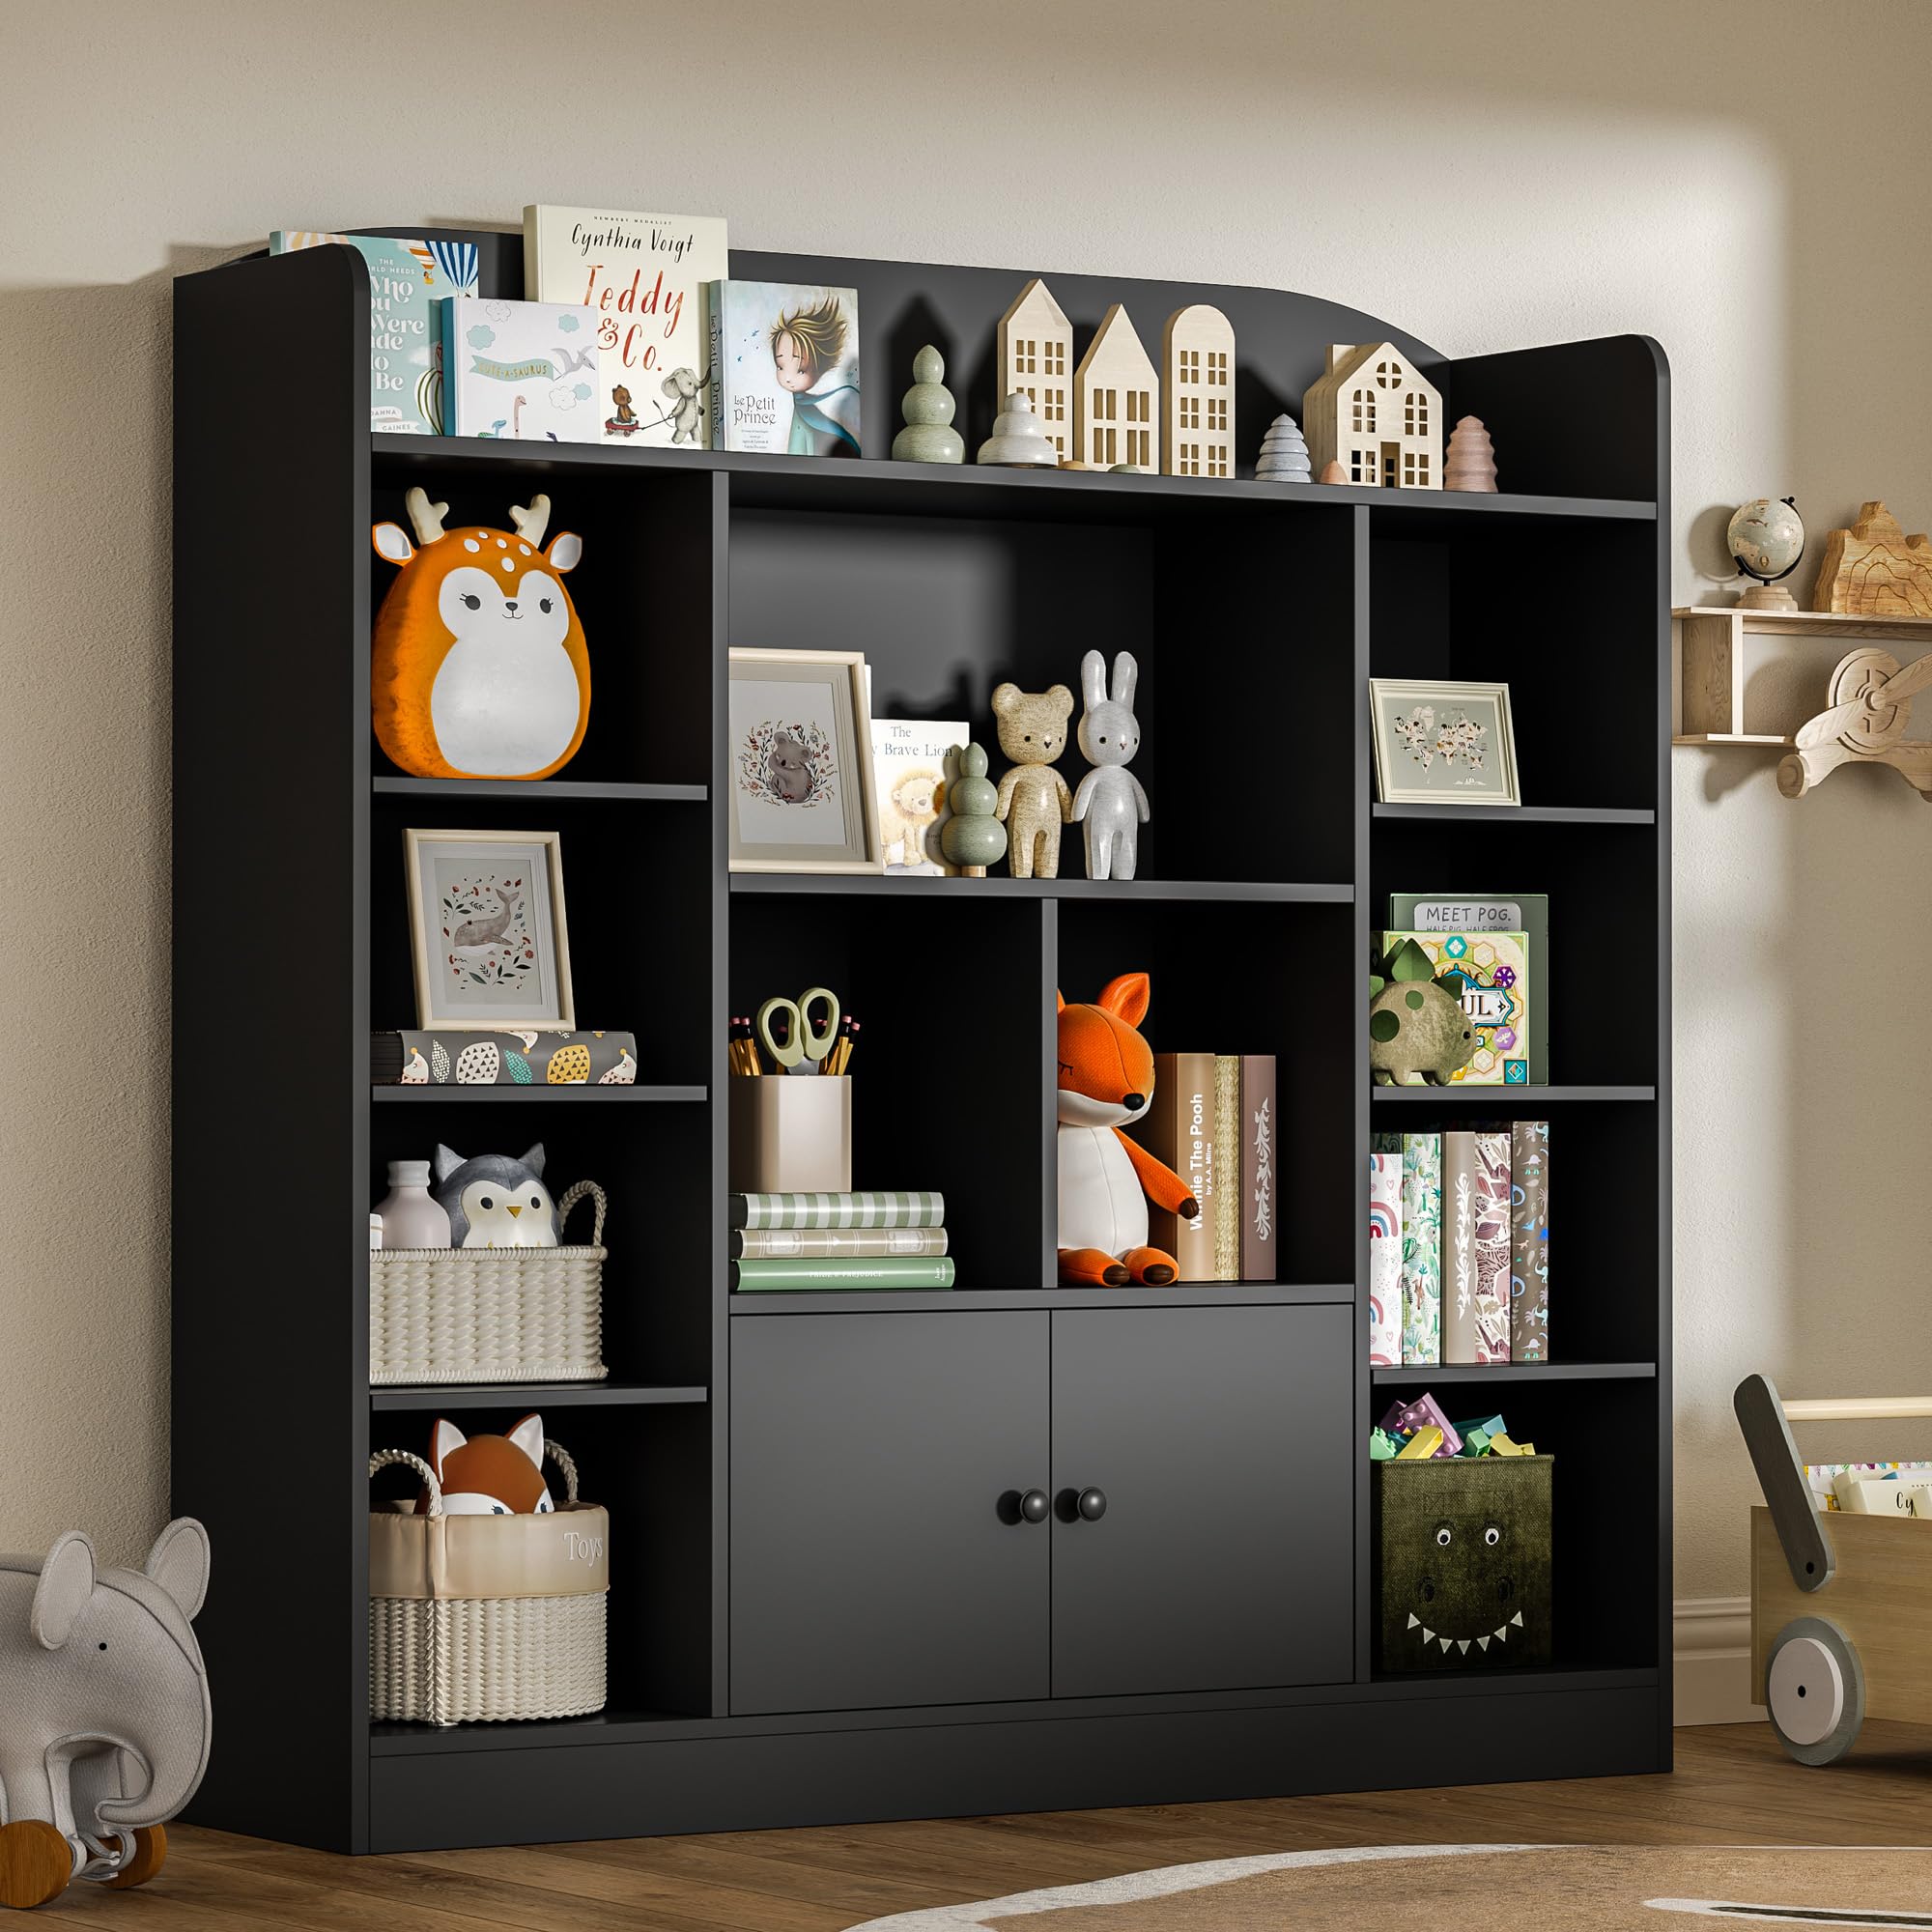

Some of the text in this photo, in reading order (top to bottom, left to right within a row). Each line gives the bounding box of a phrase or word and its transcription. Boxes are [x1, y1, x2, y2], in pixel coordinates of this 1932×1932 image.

[571, 223, 694, 264] Cynthia Voigt
[583, 265, 684, 339] Teddy
[371, 332, 403, 351] de
[371, 353, 389, 371] o
[376, 372, 404, 391] Be
[712, 381, 721, 435] Prince
[734, 395, 775, 412] Le Petit
[734, 409, 777, 425] Prince
[382, 423, 411, 432] GAINES
[890, 725, 912, 738] The
[884, 743, 919, 756] Brave
[925, 744, 952, 757] Lion
[1426, 906, 1512, 923] MEET POG.
[1461, 994, 1492, 1016] UL
[1189, 1094, 1203, 1231] Wnie The Pooh
[1206, 1185, 1212, 1196] by
[563, 1531, 604, 1567] Toys
